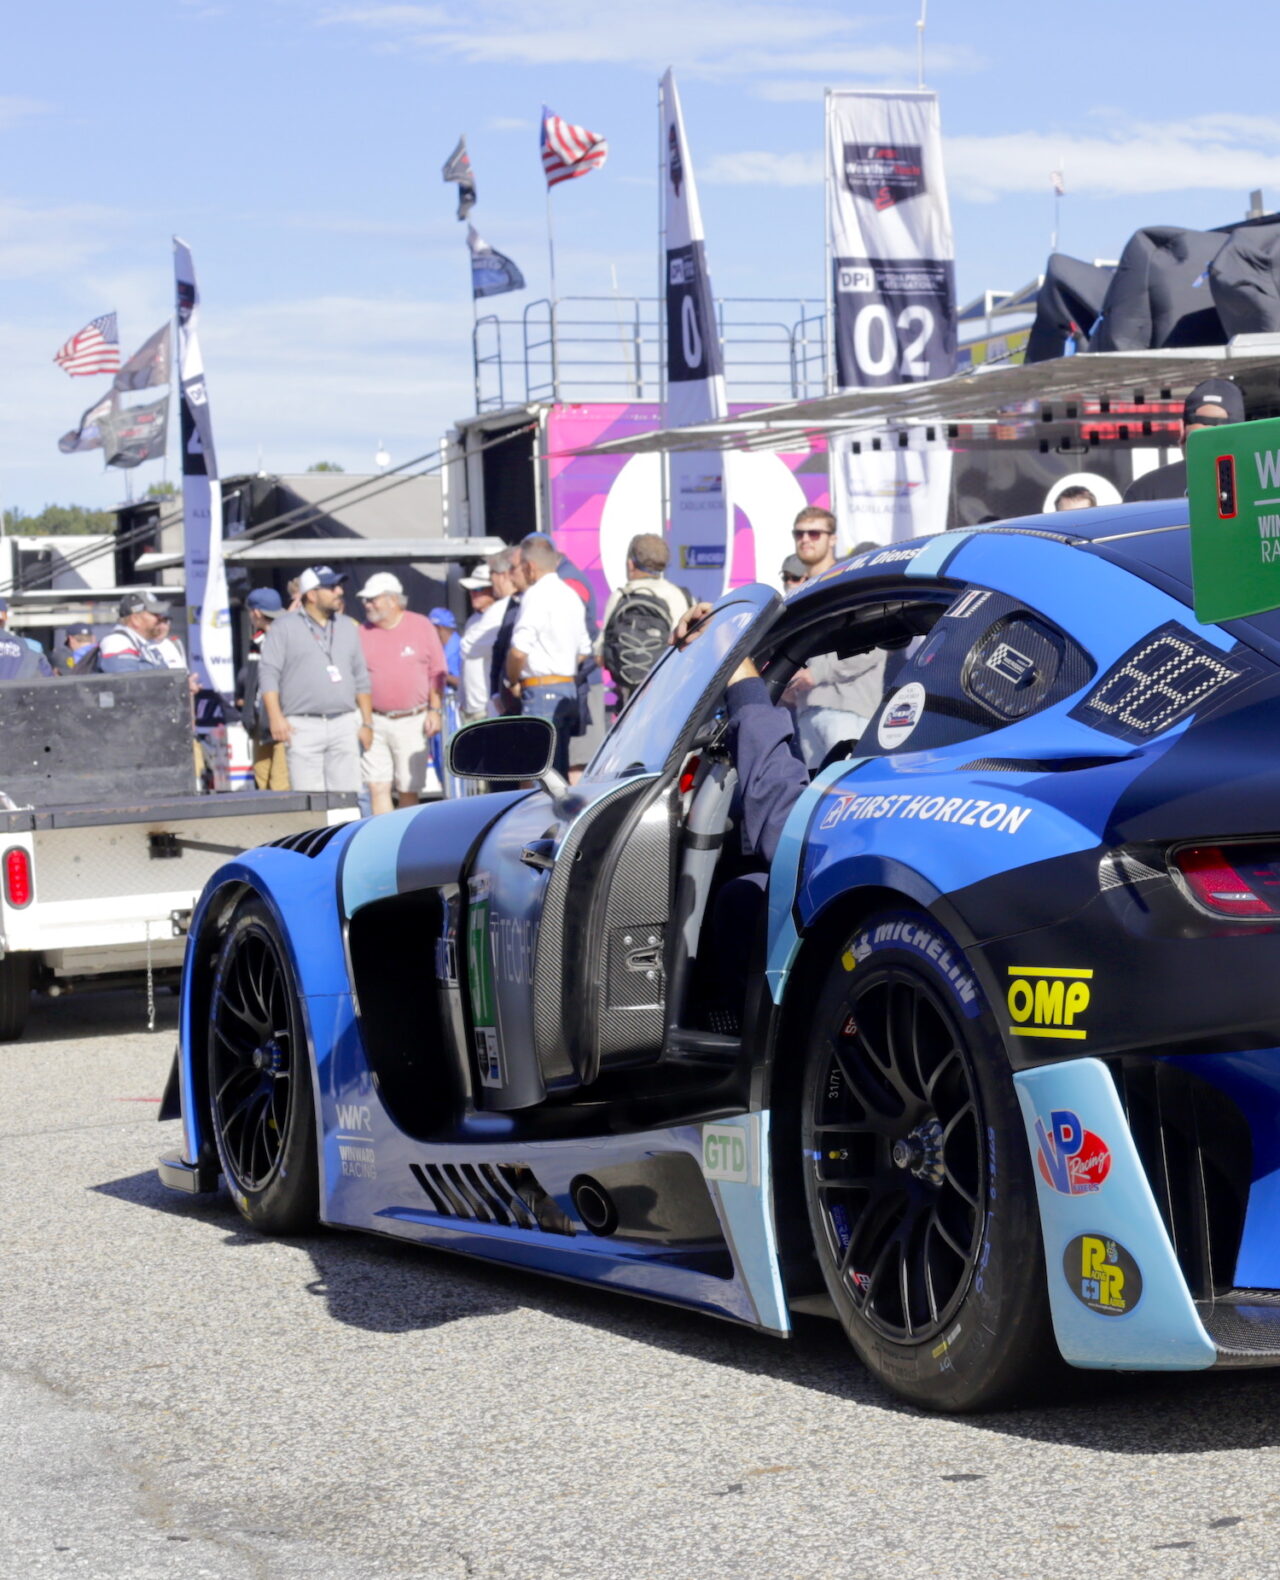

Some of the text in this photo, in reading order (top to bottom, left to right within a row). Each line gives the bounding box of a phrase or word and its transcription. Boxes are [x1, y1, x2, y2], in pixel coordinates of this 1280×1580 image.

[841, 273, 870, 287] DPi
[854, 303, 934, 377] 02
[870, 547, 929, 567] Dienst
[842, 795, 1033, 835] FIRST HORIZON
[874, 920, 976, 1005] MICHELIN
[1008, 978, 1091, 1026] OMP
[342, 1162, 377, 1180] RACING
[705, 1134, 745, 1172] GTD
[1034, 1110, 1083, 1195] VP
[1069, 1151, 1110, 1184] Racing
